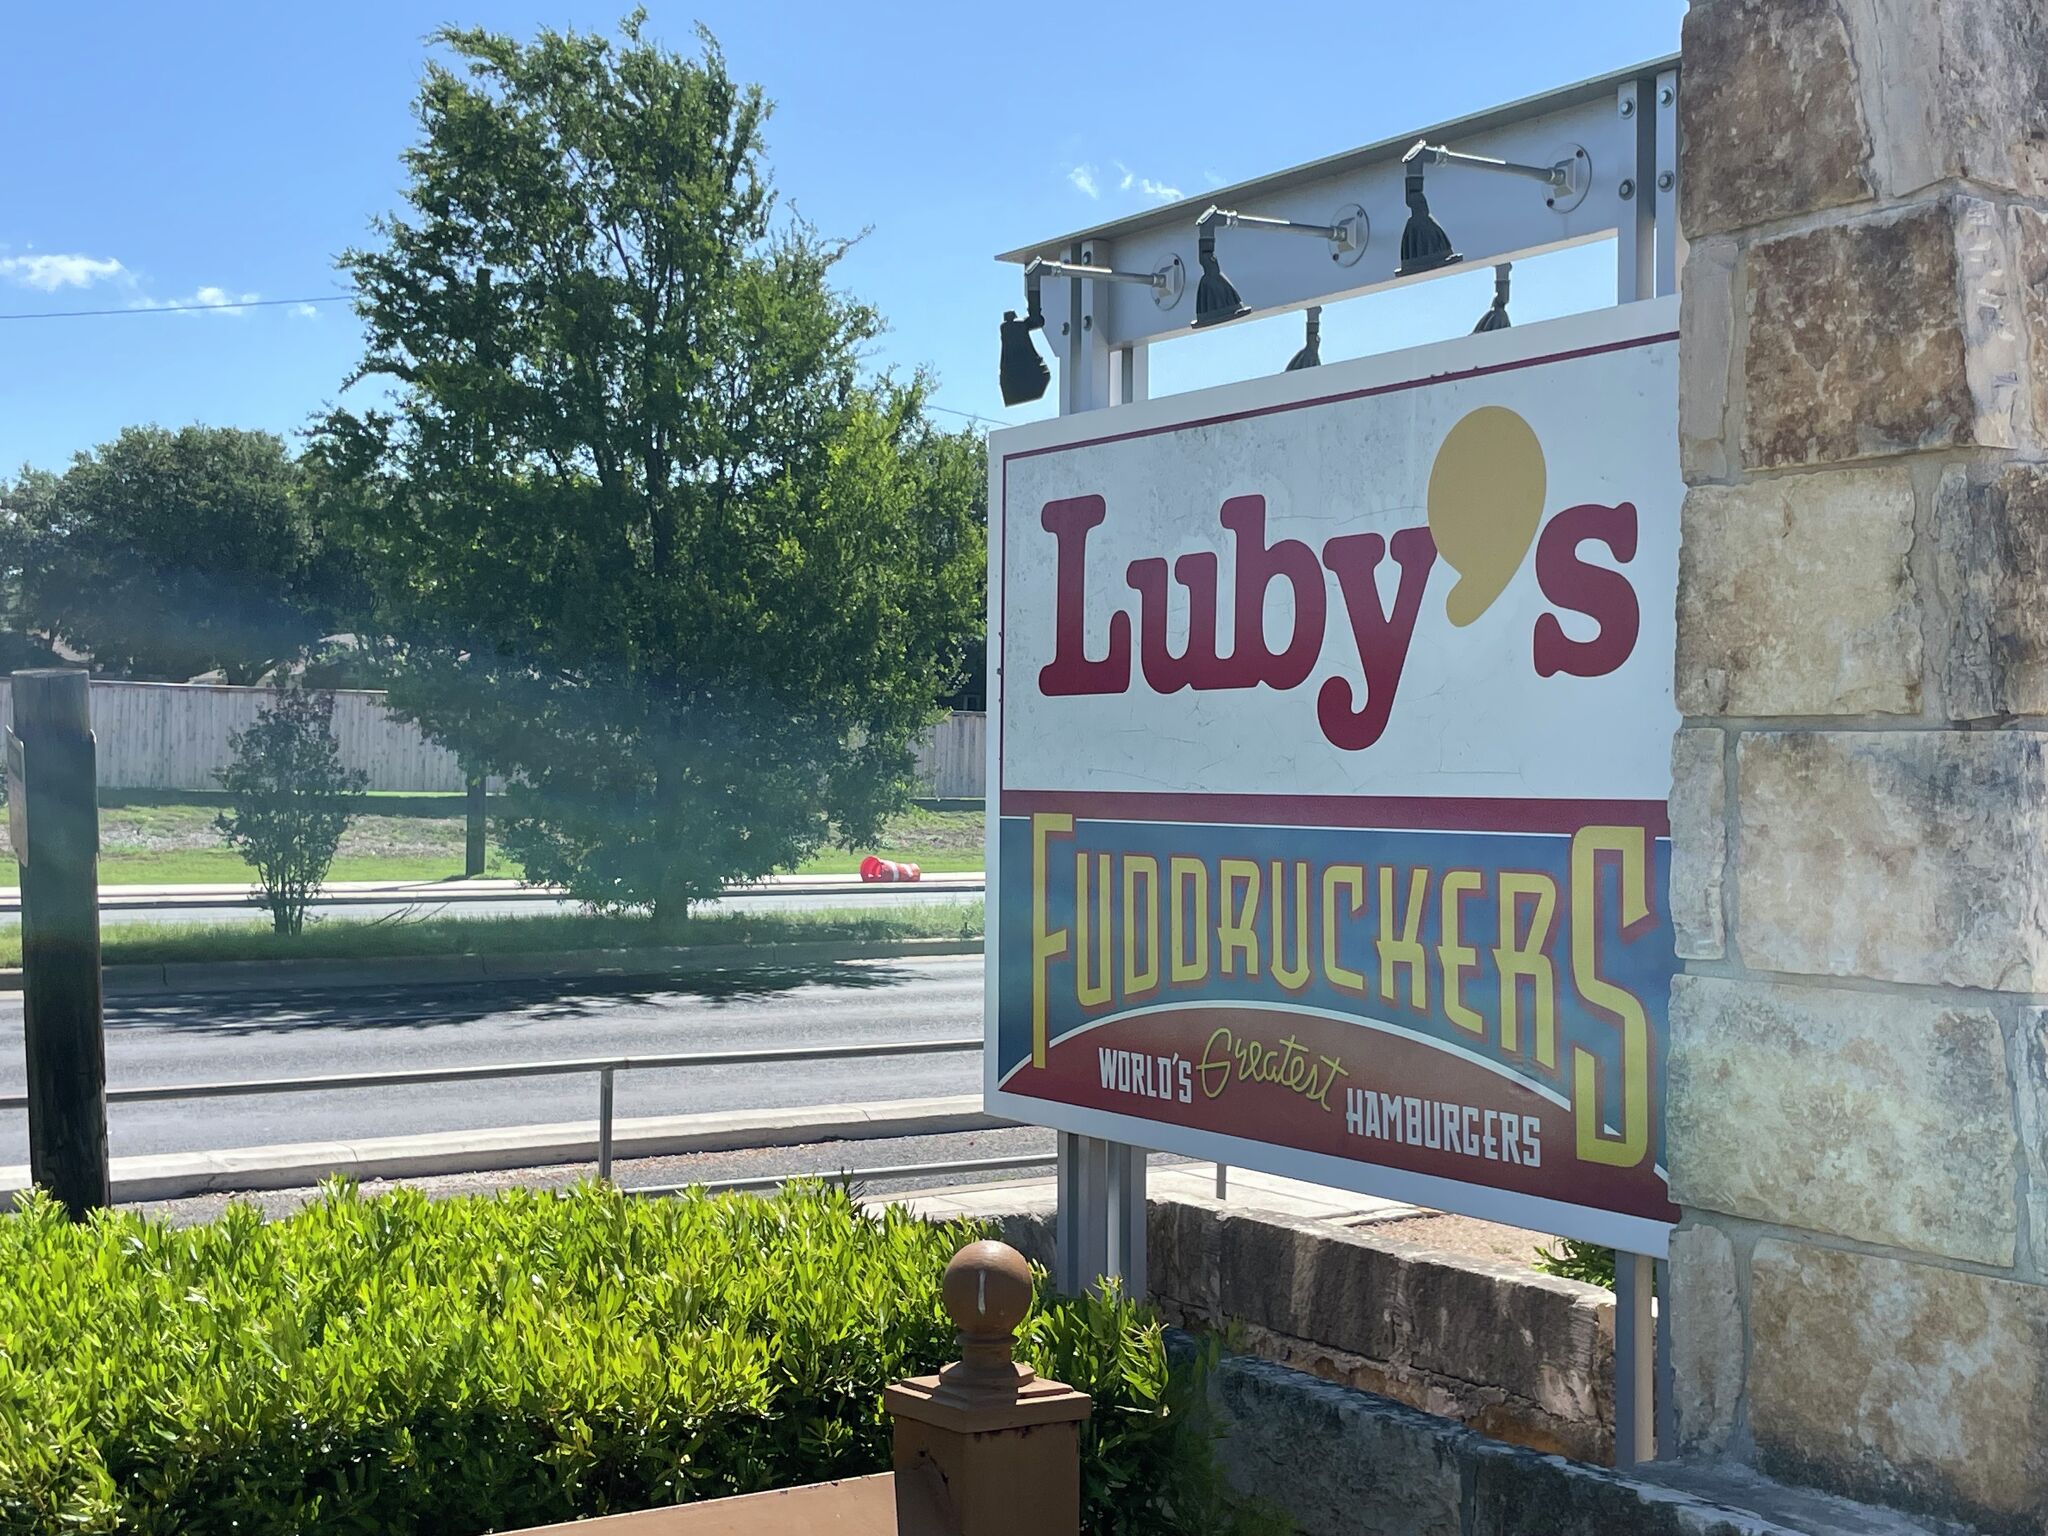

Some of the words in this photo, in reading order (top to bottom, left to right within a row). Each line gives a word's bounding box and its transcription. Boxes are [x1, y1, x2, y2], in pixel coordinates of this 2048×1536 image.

[1039, 405, 1640, 751] Luby's
[1031, 812, 1650, 1168] FUDDRUCKERS
[1098, 1047, 1193, 1105] WORLD'S
[1196, 1028, 1349, 1112] Greatest
[1346, 1087, 1542, 1168] HAMBURGERS
